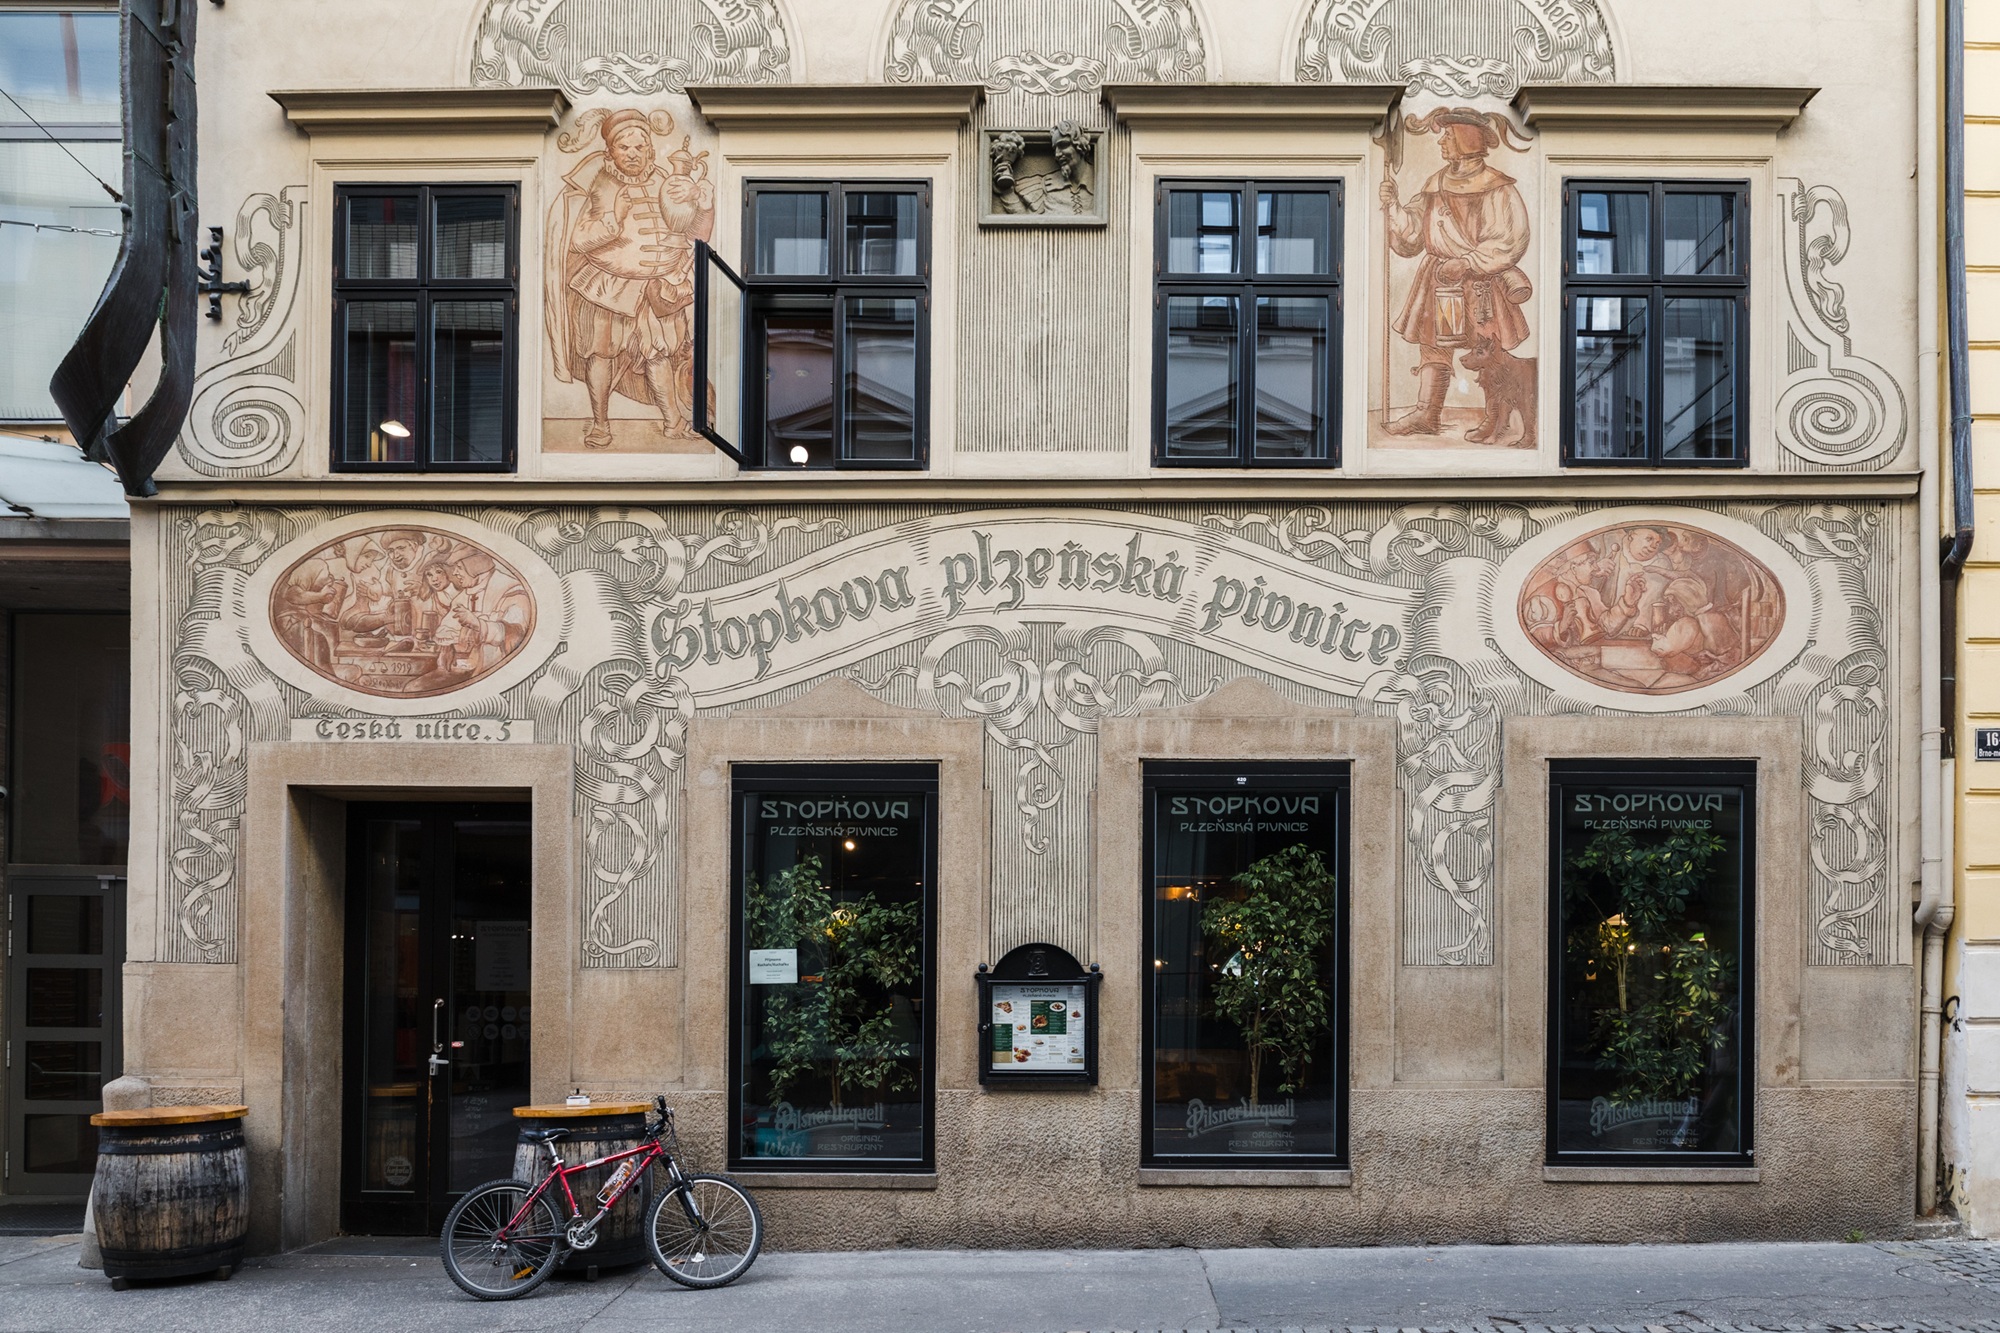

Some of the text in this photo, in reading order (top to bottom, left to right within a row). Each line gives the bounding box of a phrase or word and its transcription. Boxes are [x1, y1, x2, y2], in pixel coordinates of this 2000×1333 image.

[650, 566, 913, 681] Stopkova
[940, 530, 1188, 615] plzeňská
[316, 714, 402, 741] Česká
[761, 801, 909, 819] STOPKOVA
[1171, 796, 1319, 815] STOPKOVA
[1574, 794, 1722, 812] STOPKOVA
[770, 822, 898, 836] PLZEŇSKÁ PIVNICE
[1180, 818, 1309, 832] PLZEŇSKÁ PIVNICE
[1584, 815, 1712, 829] PLZEŇSKÁ PIVNICE
[774, 1101, 883, 1140] Pilsner Urquell
[1186, 1096, 1295, 1138] Pilsner Urquell
[1590, 1095, 1647, 1137] Pilsner
[840, 1135, 883, 1143] ORIGINAL
[1252, 1131, 1295, 1139] ORIGINAL
[764, 1136, 804, 1157] Wolt
[817, 1143, 884, 1151] RESTAURANT
